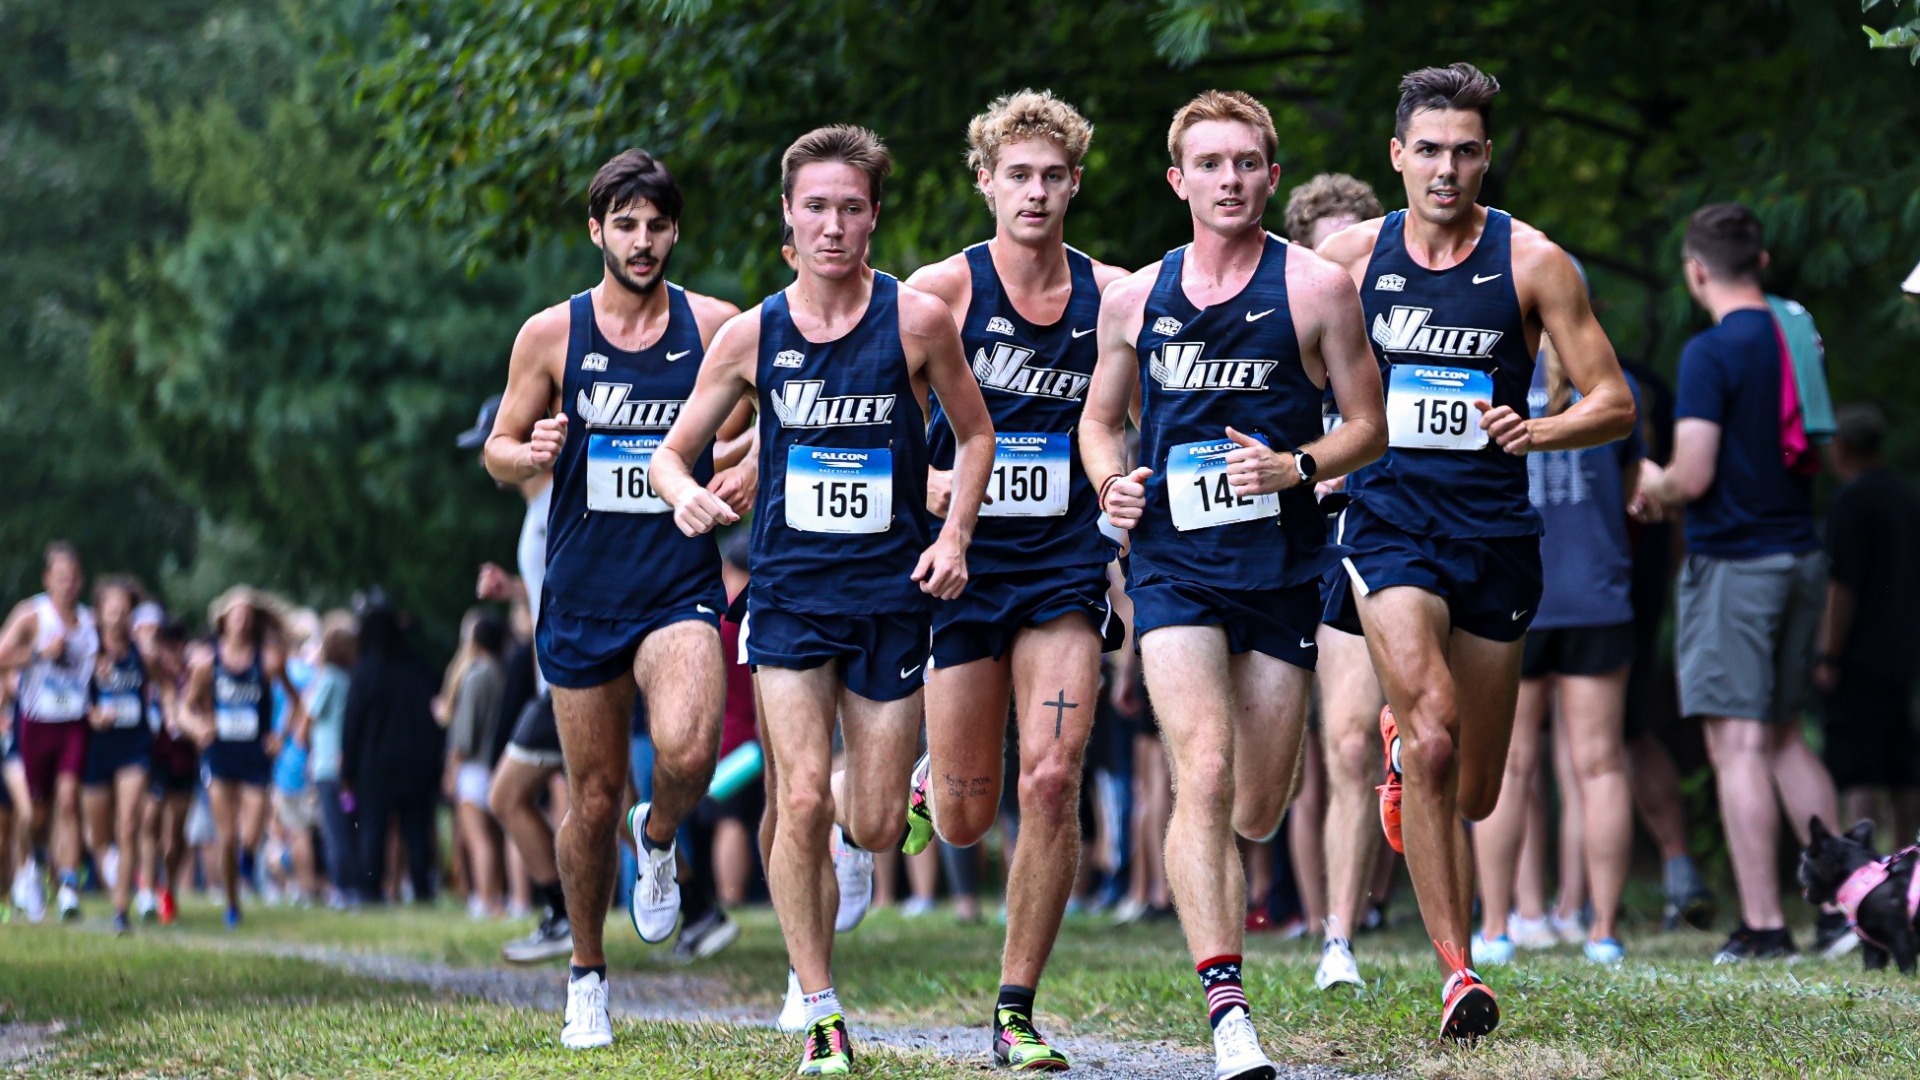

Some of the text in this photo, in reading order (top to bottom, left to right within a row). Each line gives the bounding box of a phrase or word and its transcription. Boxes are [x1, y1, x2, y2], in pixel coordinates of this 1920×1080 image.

[1385, 305, 1504, 358] VALLEY
[983, 342, 1091, 401] VALLEY
[1162, 342, 1279, 391] VALLEY
[1414, 369, 1470, 381] FALCON
[590, 382, 687, 428] VALLE
[783, 380, 897, 428] VALLEY
[1414, 398, 1468, 436] 159
[811, 451, 868, 461] FALCON
[995, 437, 1047, 445] FALCON
[812, 481, 868, 519] 155
[993, 466, 1047, 502] 150
